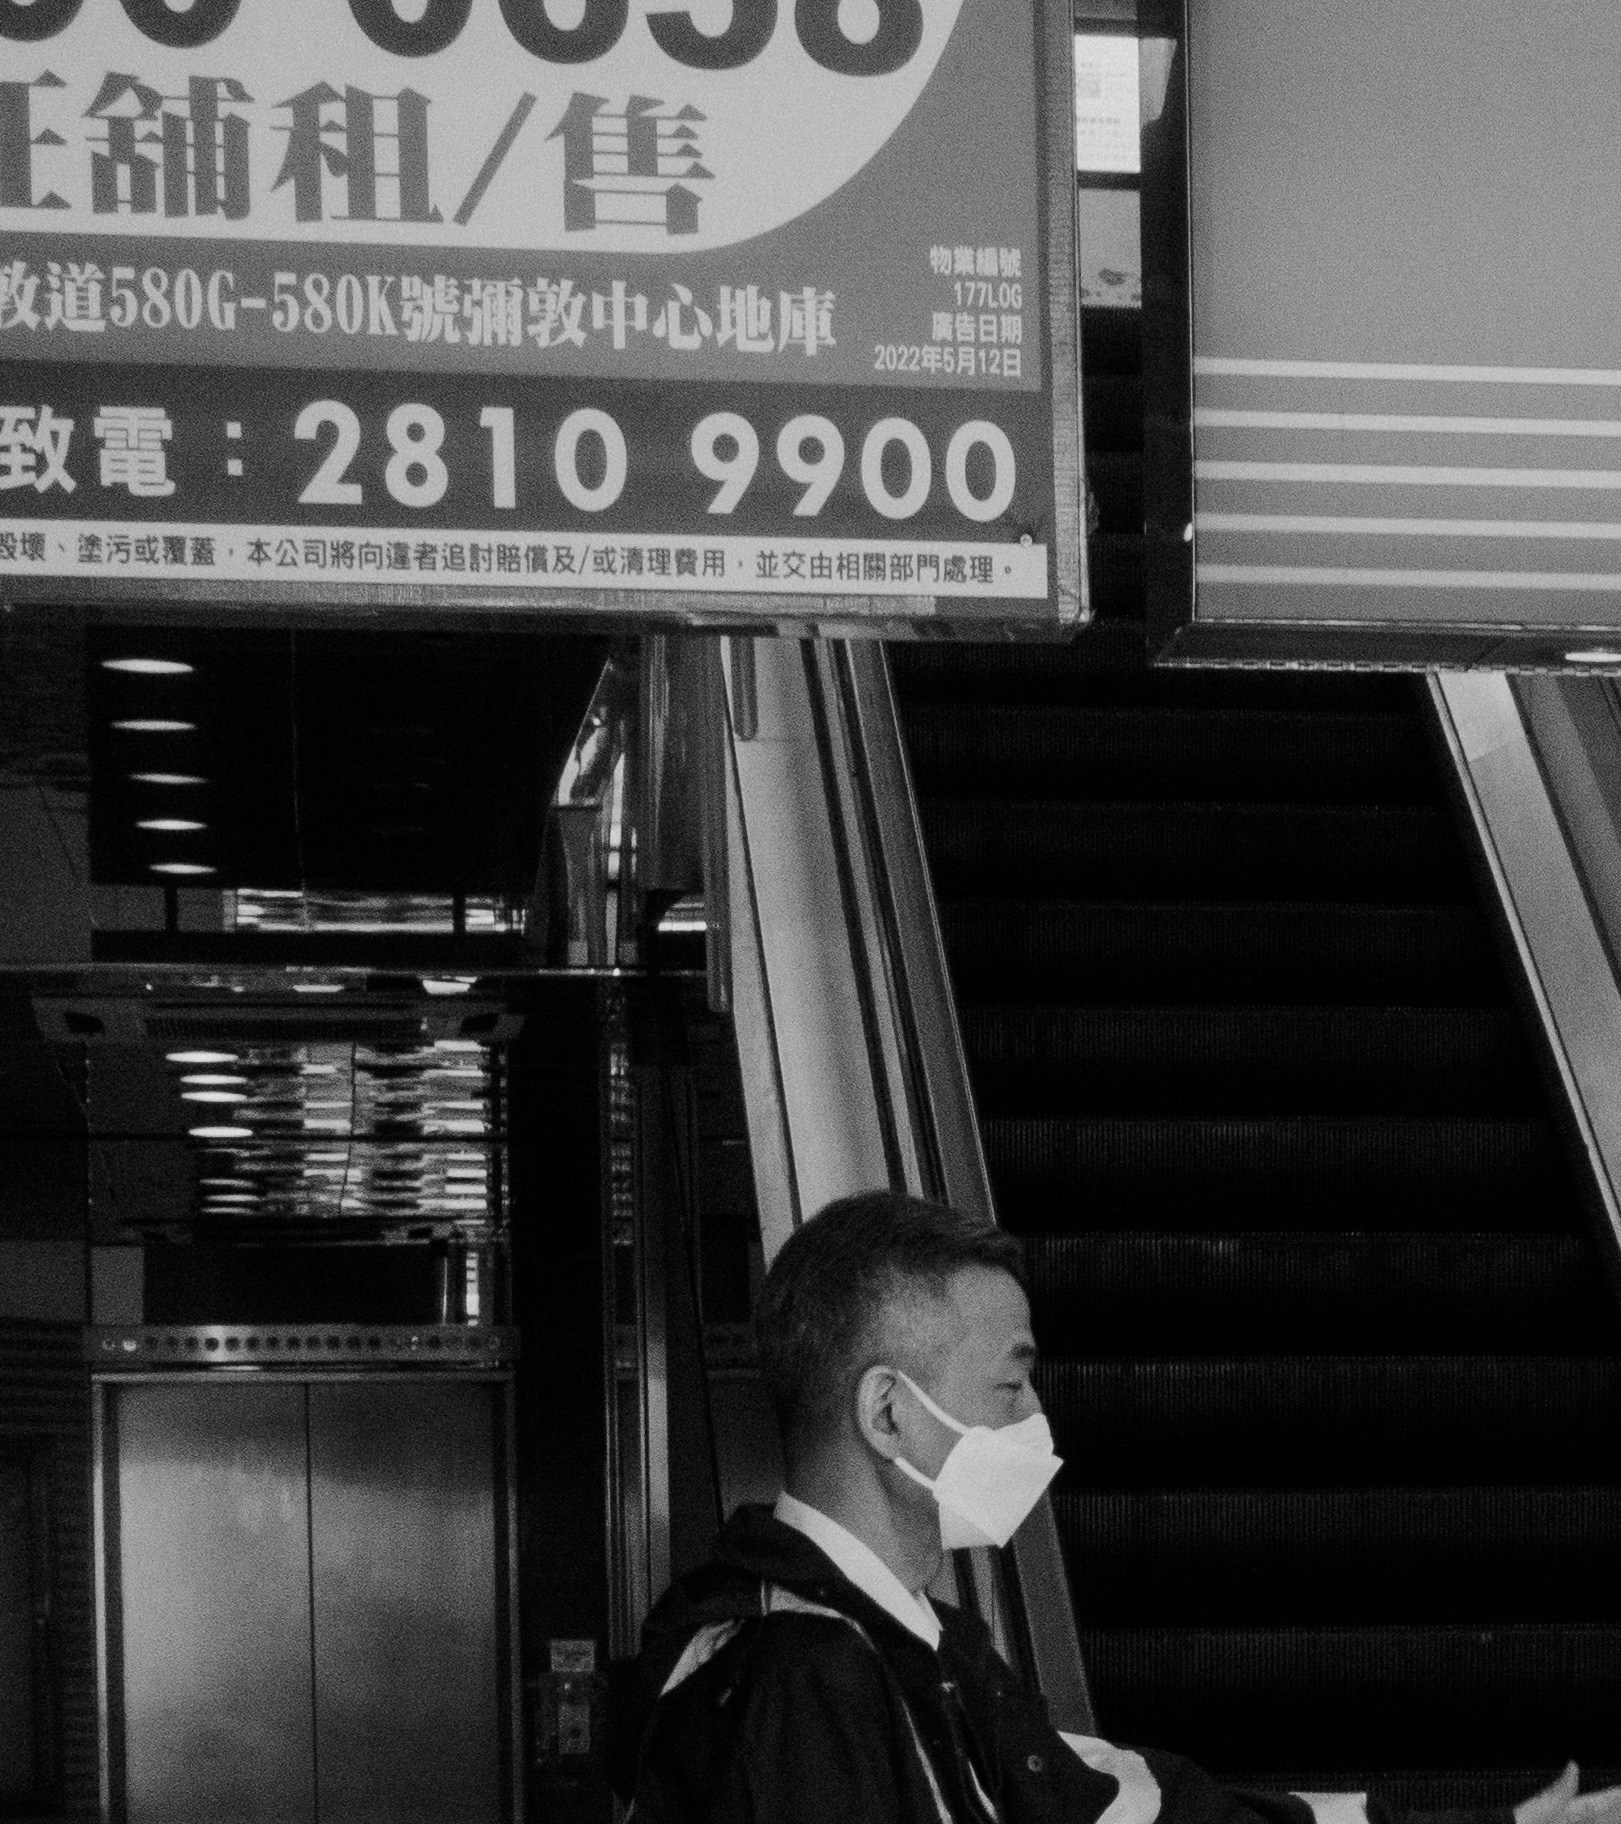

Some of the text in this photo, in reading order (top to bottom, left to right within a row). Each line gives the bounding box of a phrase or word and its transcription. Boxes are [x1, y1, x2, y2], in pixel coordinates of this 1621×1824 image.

[932, 311, 1022, 344] 廣告日期
[873, 344, 1021, 377] 2022年5月12日
[294, 400, 627, 512] 2810
[690, 411, 1016, 522] 9900
